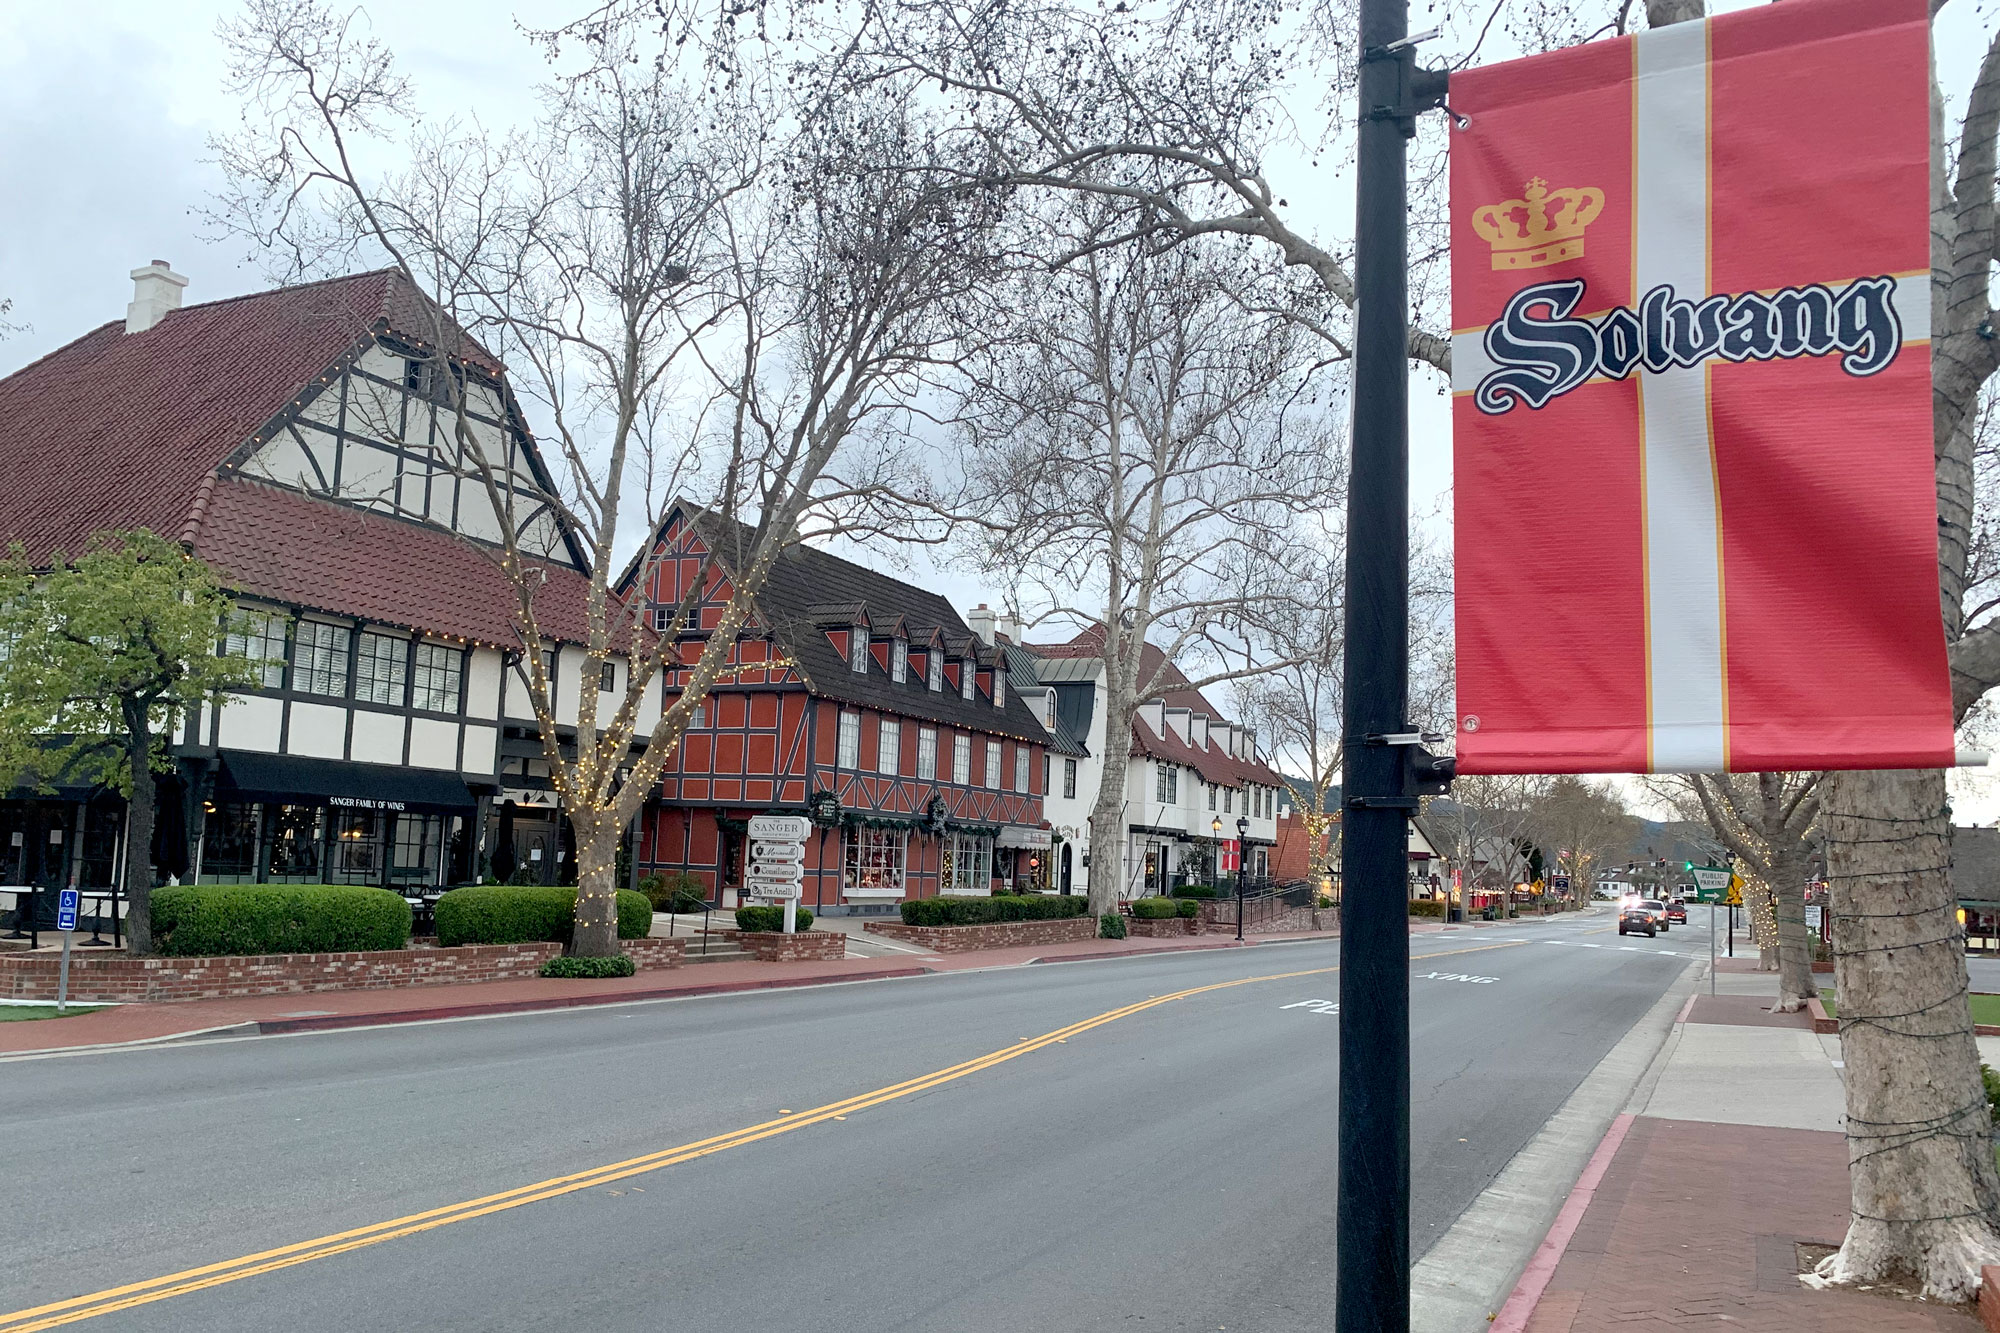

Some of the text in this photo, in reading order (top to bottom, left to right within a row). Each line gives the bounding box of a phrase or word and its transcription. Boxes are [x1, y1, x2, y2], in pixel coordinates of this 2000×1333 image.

[1474, 275, 1903, 415] Solvang
[330, 796, 405, 811] SANGER FAMILY OF WINES
[753, 823, 799, 833] SANGER
[761, 866, 796, 876] Consilience
[763, 886, 793, 896] Tre Anelli
[1415, 971, 1501, 985] XING
[1279, 998, 1340, 1014] PE
